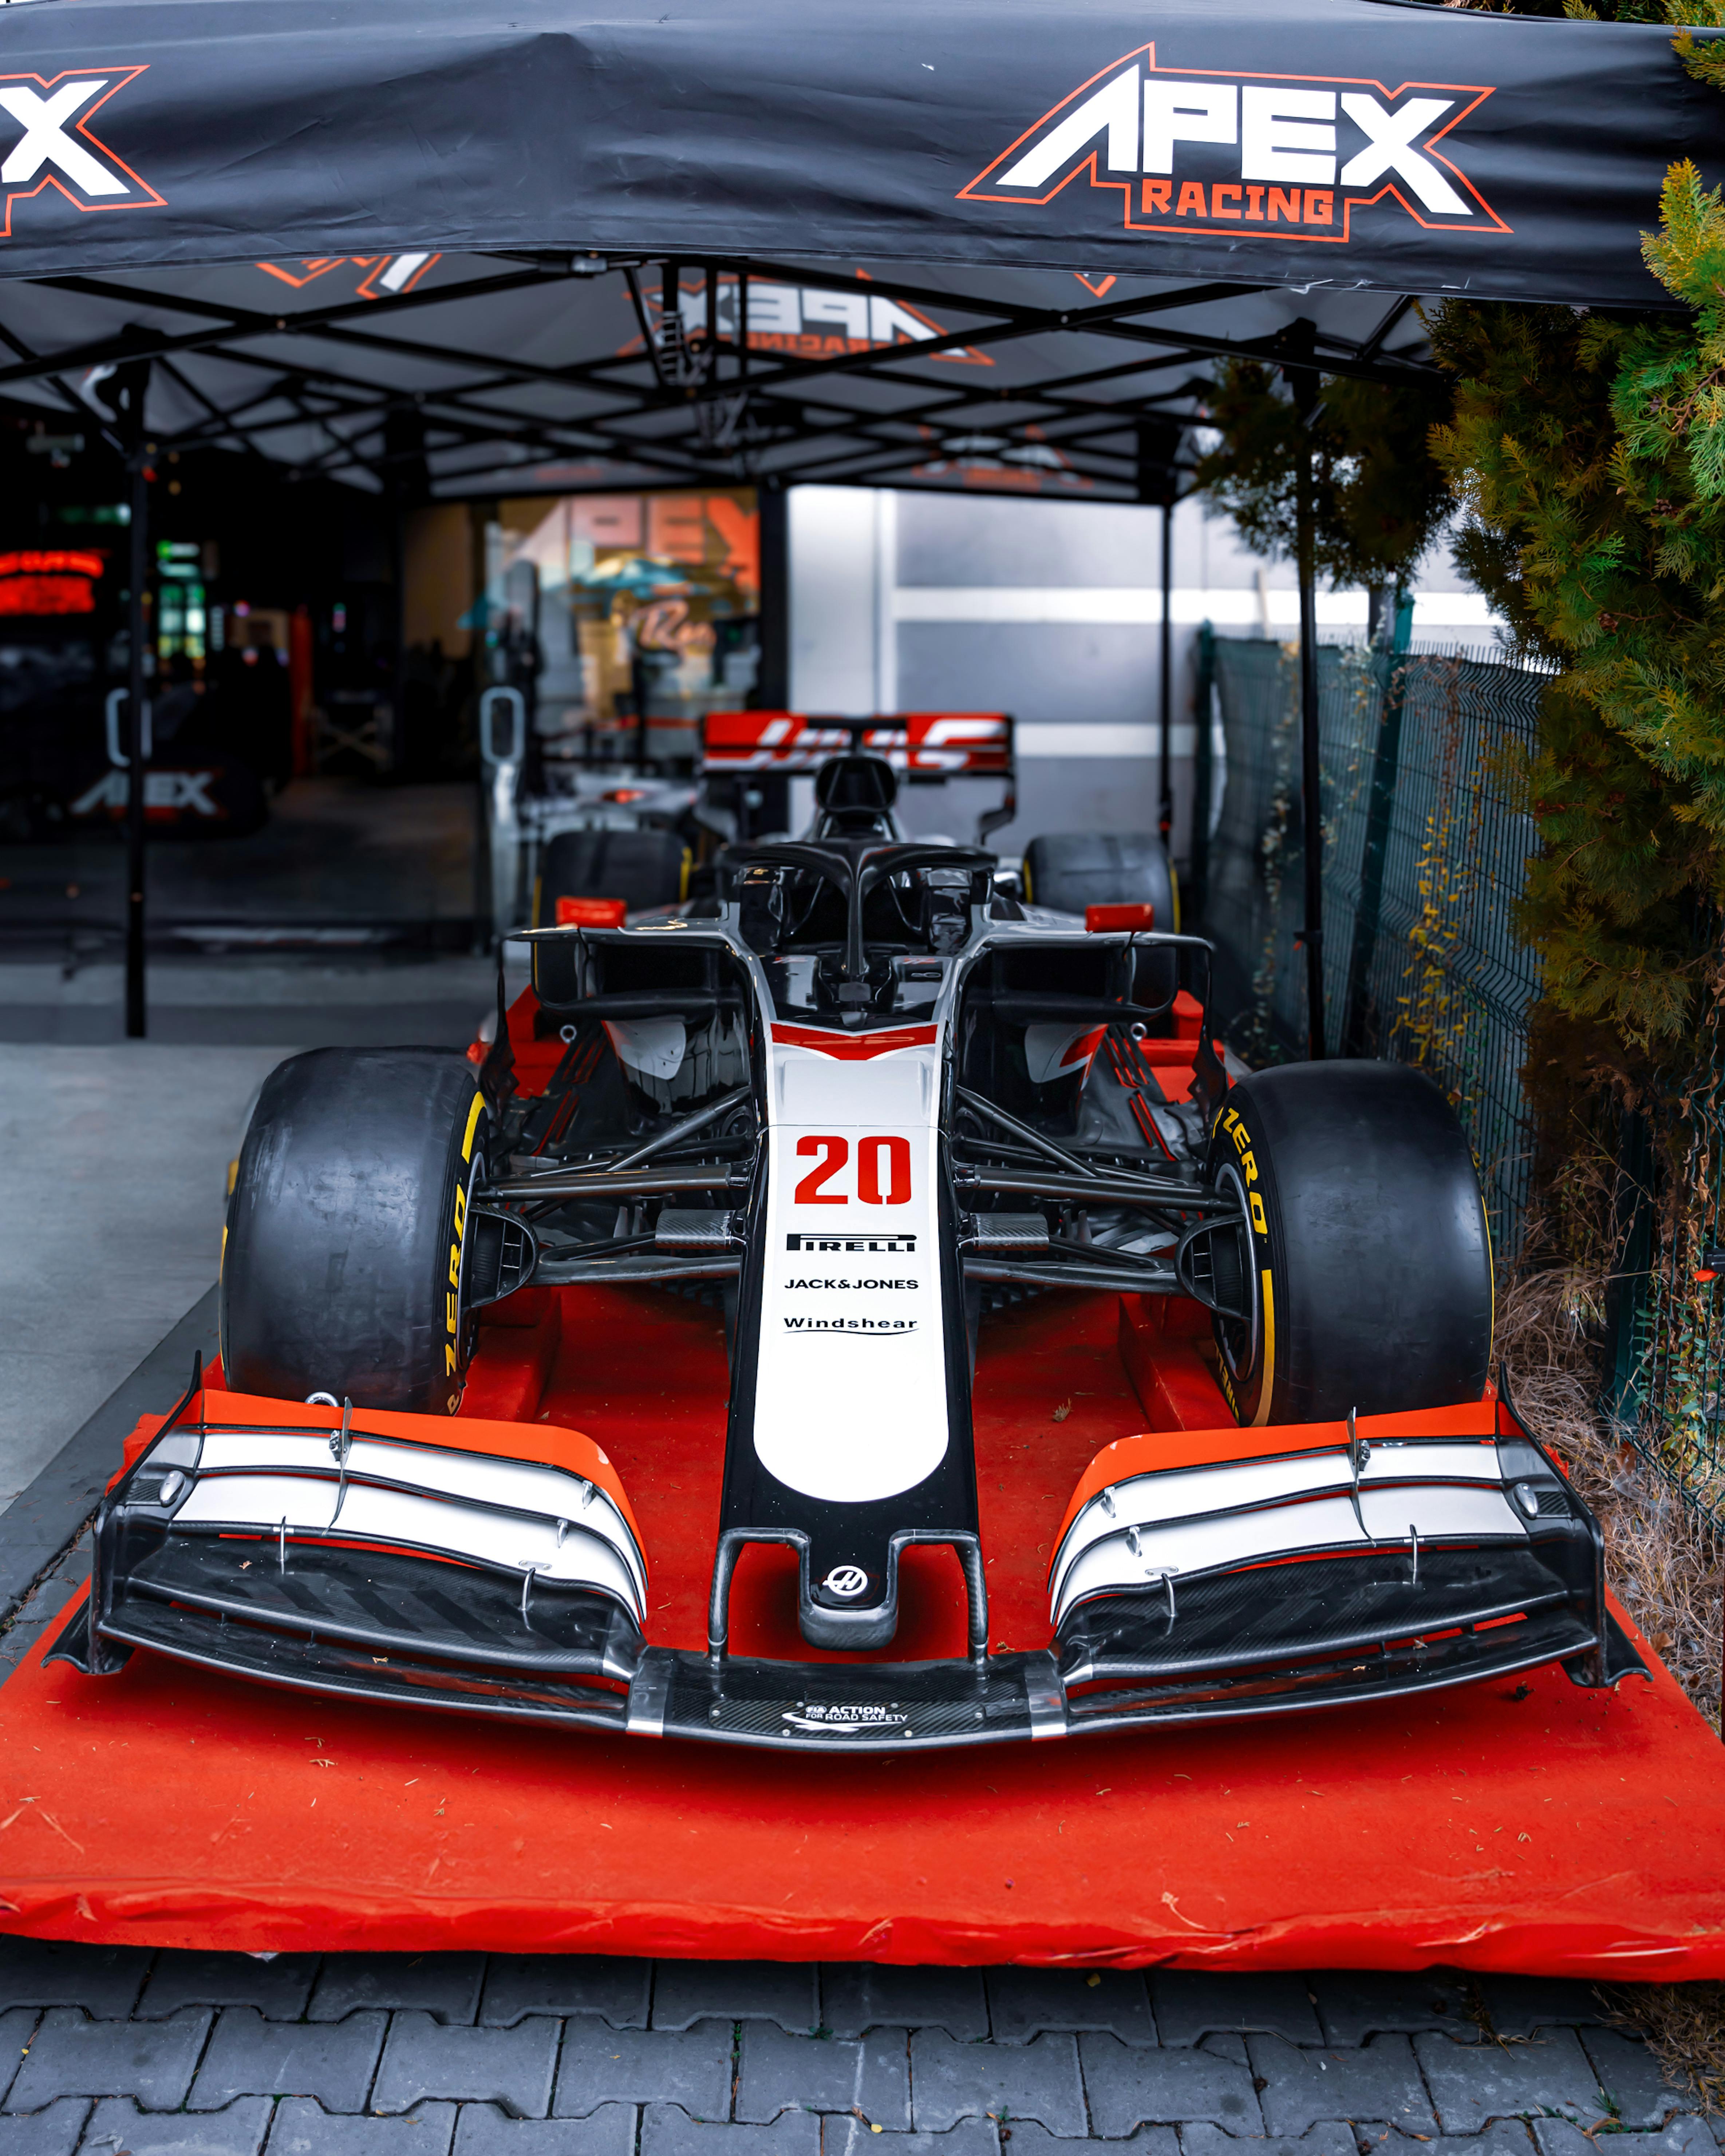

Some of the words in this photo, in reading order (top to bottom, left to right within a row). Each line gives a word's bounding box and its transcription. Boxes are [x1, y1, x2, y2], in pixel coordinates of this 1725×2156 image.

[996, 64, 1473, 215] APEX
[1142, 179, 1333, 225] RACING
[794, 1136, 911, 1204] 20
[1223, 1108, 1268, 1235] ZERO
[786, 1234, 917, 1251] PIRELLI
[445, 1183, 466, 1377] ZERO
[784, 1279, 919, 1289] JACK&JONES
[784, 1318, 917, 1328] Windshear
[806, 1706, 827, 1714] FIA
[829, 1706, 885, 1714] ACTION
